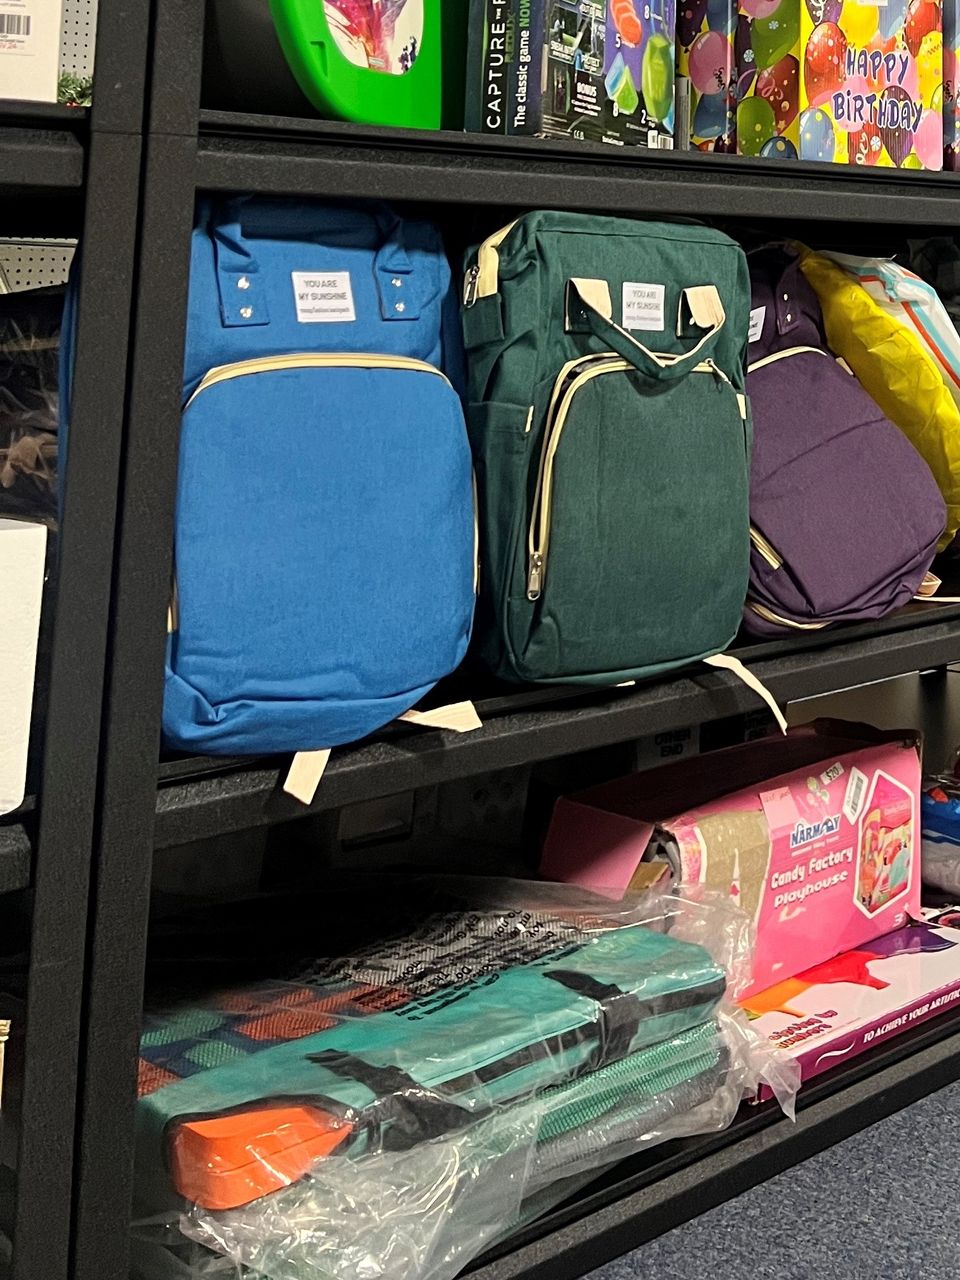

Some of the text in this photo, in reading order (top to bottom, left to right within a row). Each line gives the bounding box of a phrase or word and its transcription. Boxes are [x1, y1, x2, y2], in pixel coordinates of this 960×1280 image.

[520, 30, 531, 63] game
[615, 33, 621, 48] 5
[486, 22, 506, 129] CAPTURE
[516, 65, 528, 103] classic
[846, 48, 908, 85] HAPPY
[514, 105, 526, 128] The
[641, 109, 646, 124] 2
[303, 280, 338, 288] YOU ARE
[771, 847, 854, 889] Candy Factory
[774, 870, 849, 908] Playhouse
[863, 1030, 875, 1043] TO
[875, 1014, 908, 1038] ACHIEVE
[909, 1004, 931, 1021] YOUR
[930, 988, 960, 1010] ARTISTIC
